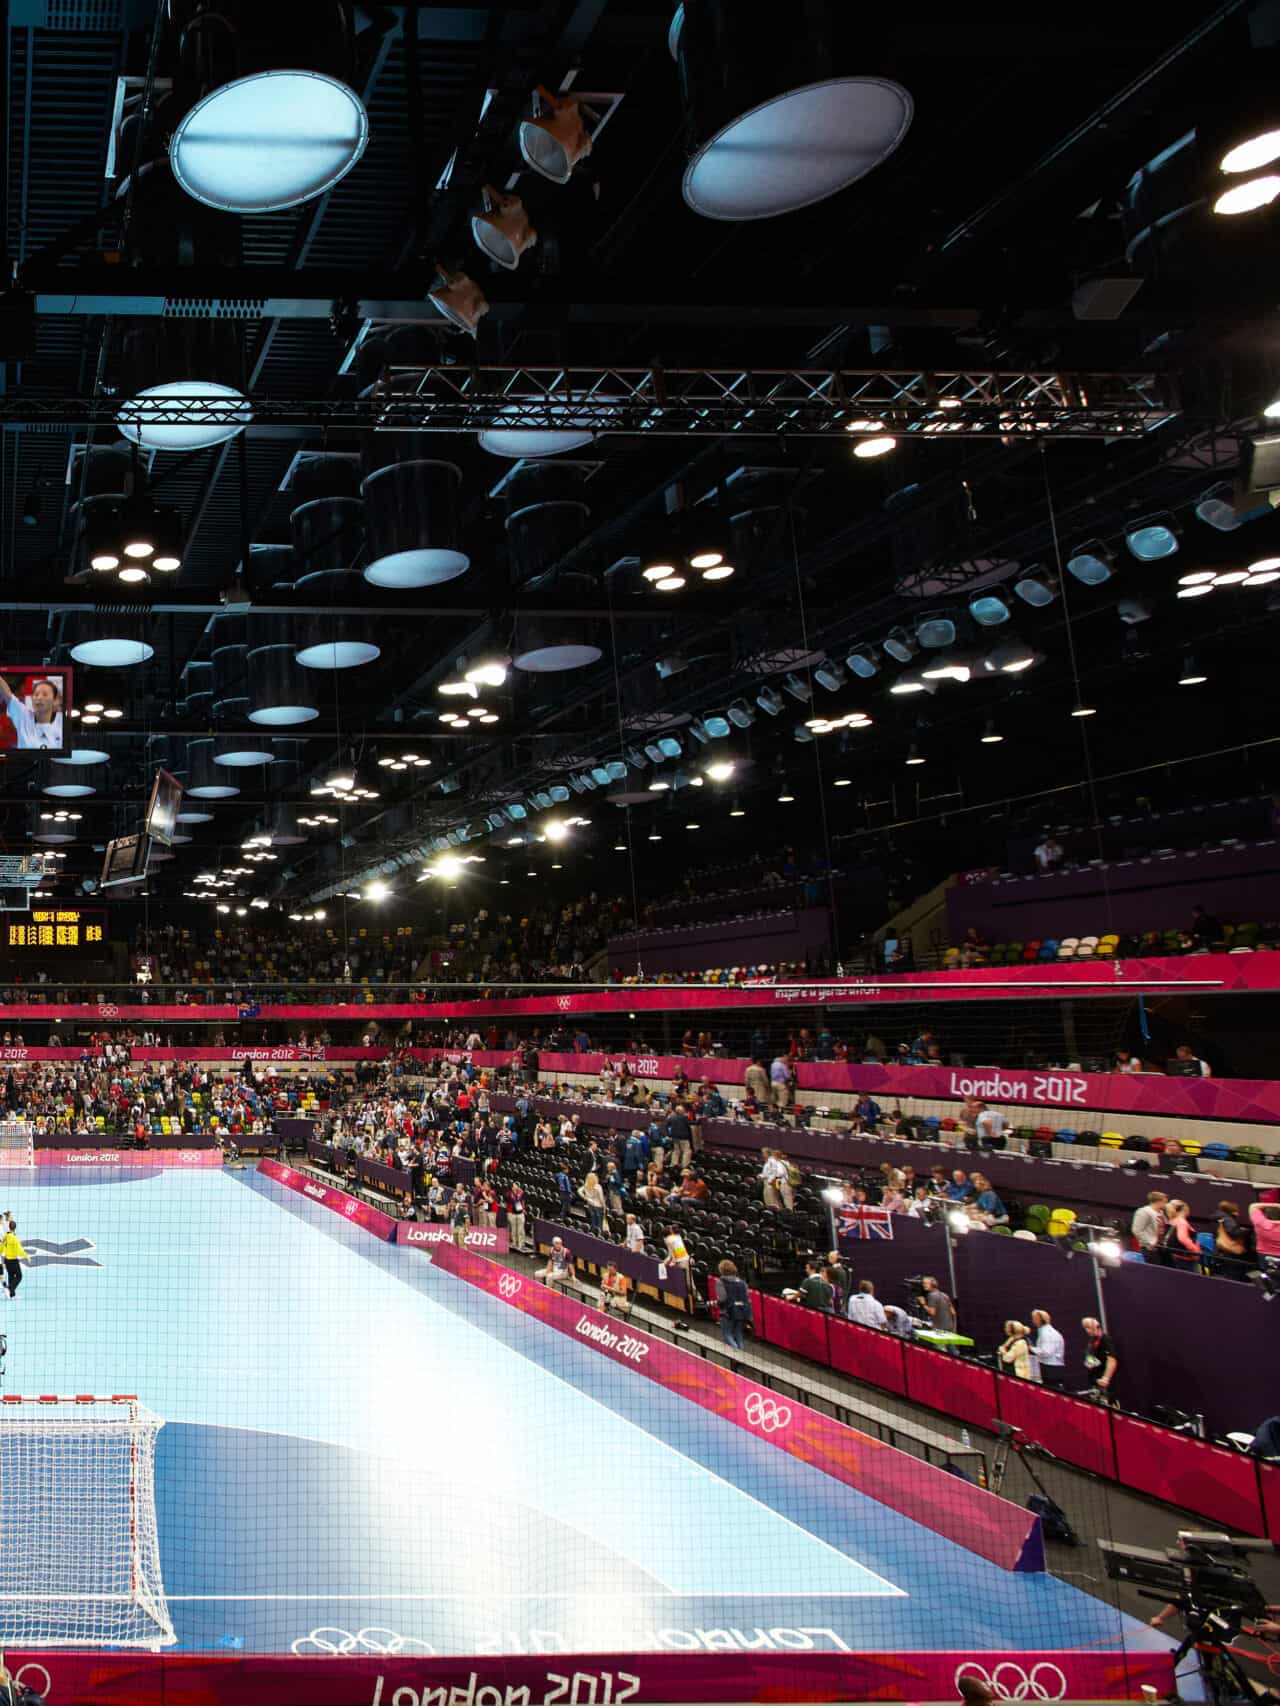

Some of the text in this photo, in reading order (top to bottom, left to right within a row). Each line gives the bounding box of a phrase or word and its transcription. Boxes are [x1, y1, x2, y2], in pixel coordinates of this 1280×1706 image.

[4, 1048, 29, 1060] 2012
[232, 1048, 295, 1060] London 2012
[637, 1059, 659, 1076] 2012
[950, 1072, 1088, 1103] London 2012
[67, 1152, 120, 1162] London 2012
[464, 1232, 498, 1247] 2012
[576, 1314, 650, 1363] London 2012
[361, 1671, 641, 1706] London 2012
